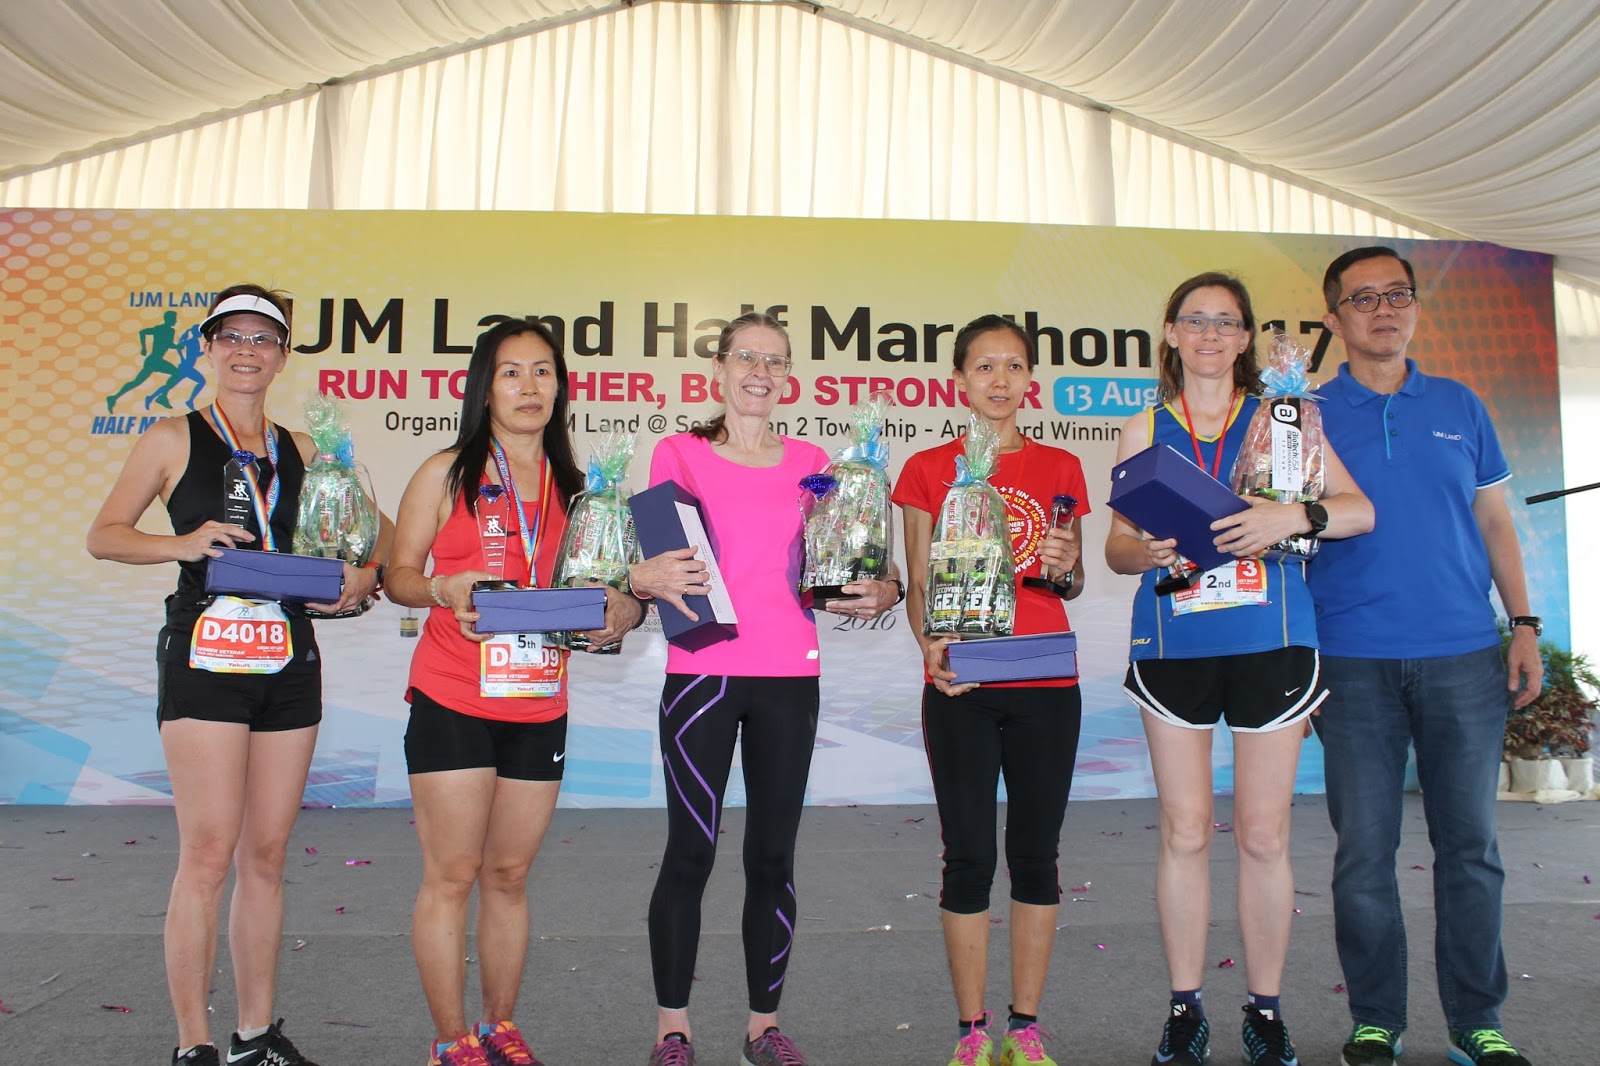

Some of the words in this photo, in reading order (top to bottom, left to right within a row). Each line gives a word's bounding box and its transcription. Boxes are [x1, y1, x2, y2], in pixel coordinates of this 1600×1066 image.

[130, 292, 162, 307] IJM
[433, 298, 614, 357] Lnd
[811, 305, 1151, 368] Marhon
[318, 369, 407, 400] RUN
[421, 370, 666, 411] TOHER,
[813, 375, 1043, 410] STRONR
[1065, 384, 1093, 412] 13
[1101, 381, 1160, 412] Aug
[91, 416, 136, 434] HALF
[385, 411, 459, 436] Organi
[585, 413, 640, 434] Land
[647, 414, 667, 434] @
[796, 416, 808, 436] 2
[815, 417, 917, 443] Towhip
[1051, 421, 1122, 441] Winnin
[1030, 509, 1040, 522] LSD
[1015, 531, 1040, 564] INTERVALS
[1206, 574, 1231, 589] 2nd
[933, 594, 961, 610] GEL
[202, 620, 284, 644] D4018
[518, 634, 536, 649] 5th
[490, 646, 560, 667] D09
